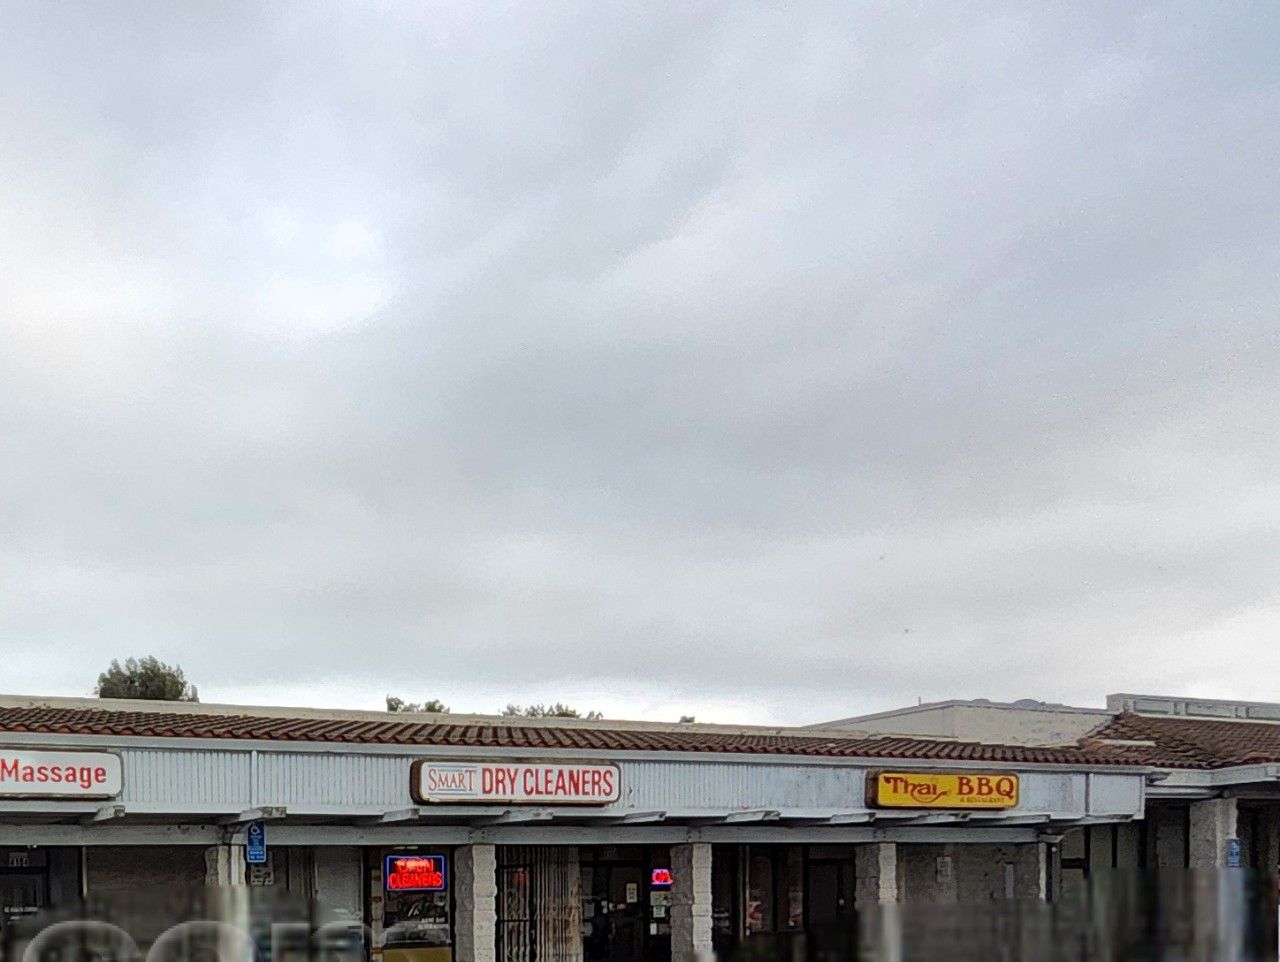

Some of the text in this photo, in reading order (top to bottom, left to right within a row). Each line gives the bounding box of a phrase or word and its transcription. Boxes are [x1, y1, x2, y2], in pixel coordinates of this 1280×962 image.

[0, 758, 107, 789] Massage
[428, 767, 613, 797] SMART DRY CLEANERS
[884, 776, 1014, 803] Thai BBQ
[395, 858, 434, 873] OPEN
[389, 872, 443, 889] CLEANERS
